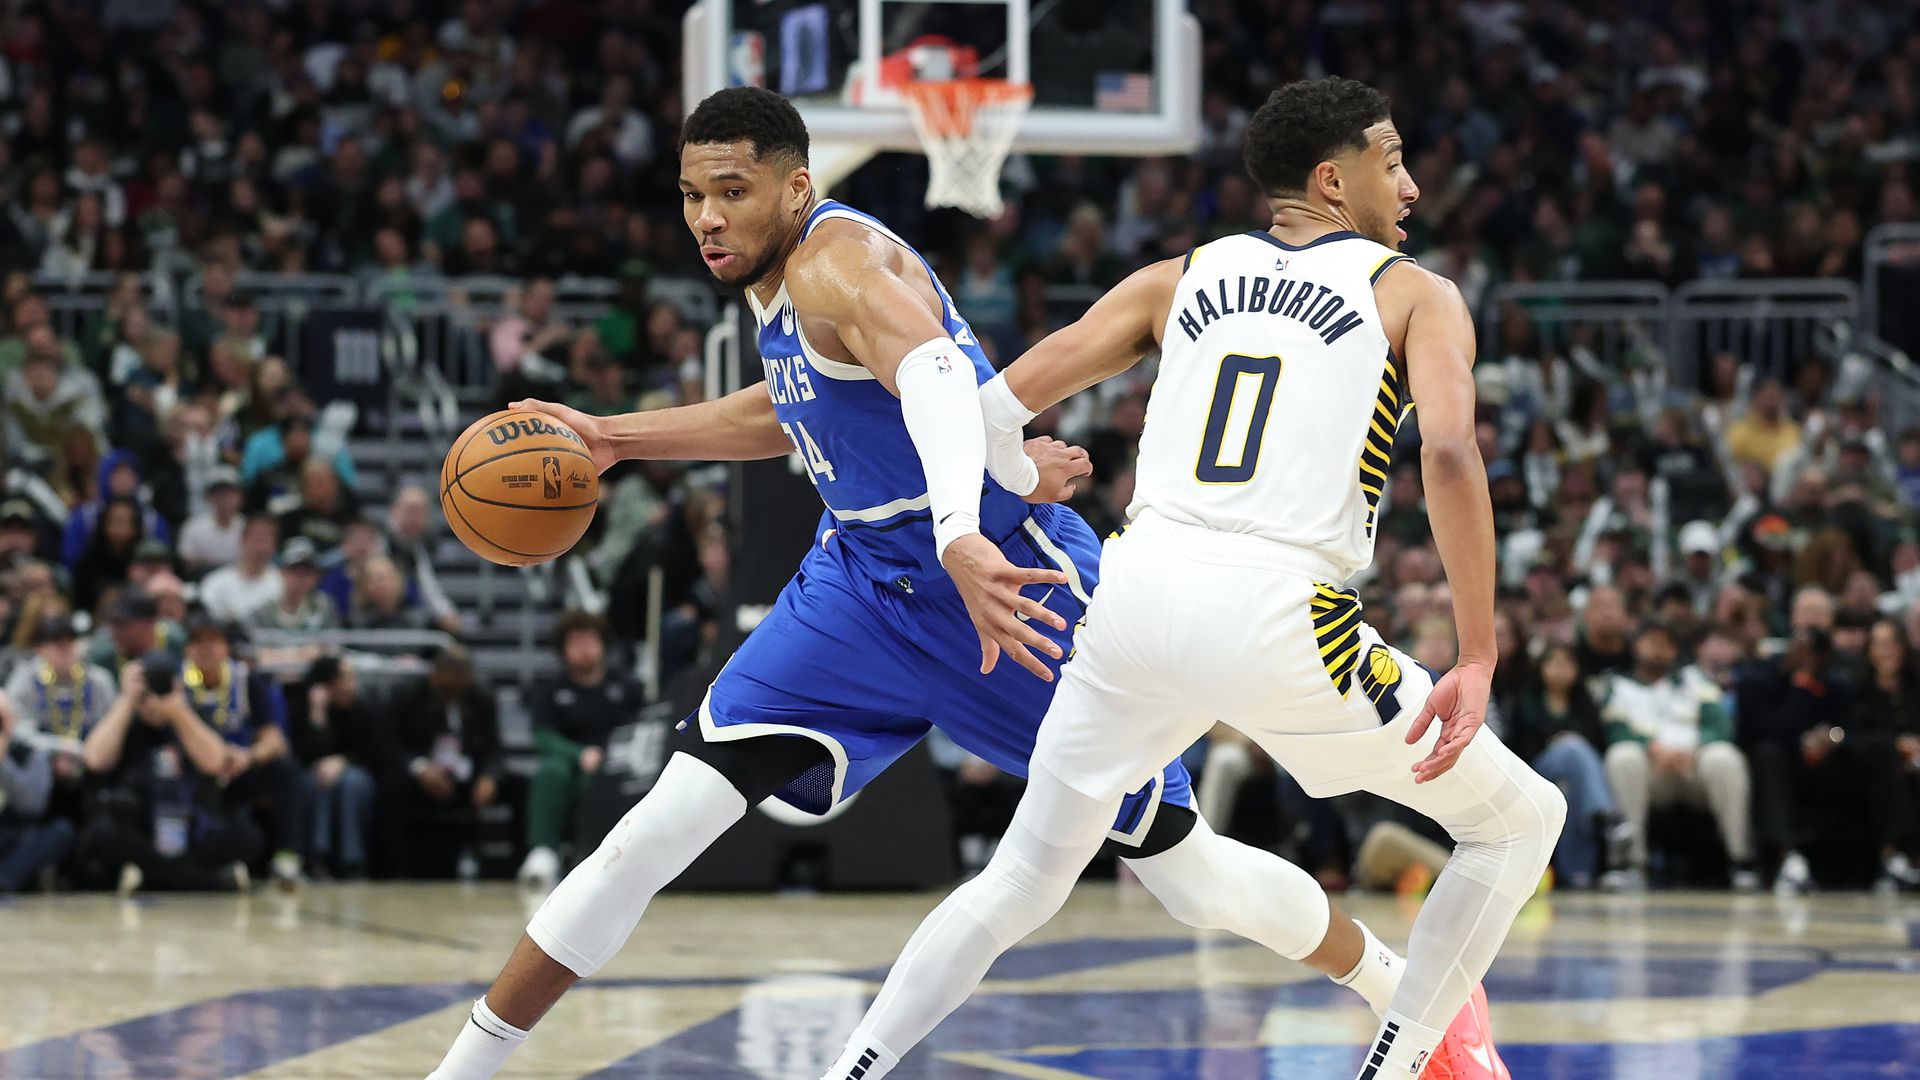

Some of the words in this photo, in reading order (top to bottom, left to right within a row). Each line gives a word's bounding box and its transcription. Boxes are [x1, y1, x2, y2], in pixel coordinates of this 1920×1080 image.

[1178, 276, 1364, 345] HALIBURTON
[762, 355, 816, 405] UCKS
[487, 417, 586, 445] Wilson
[1193, 352, 1283, 485] 0
